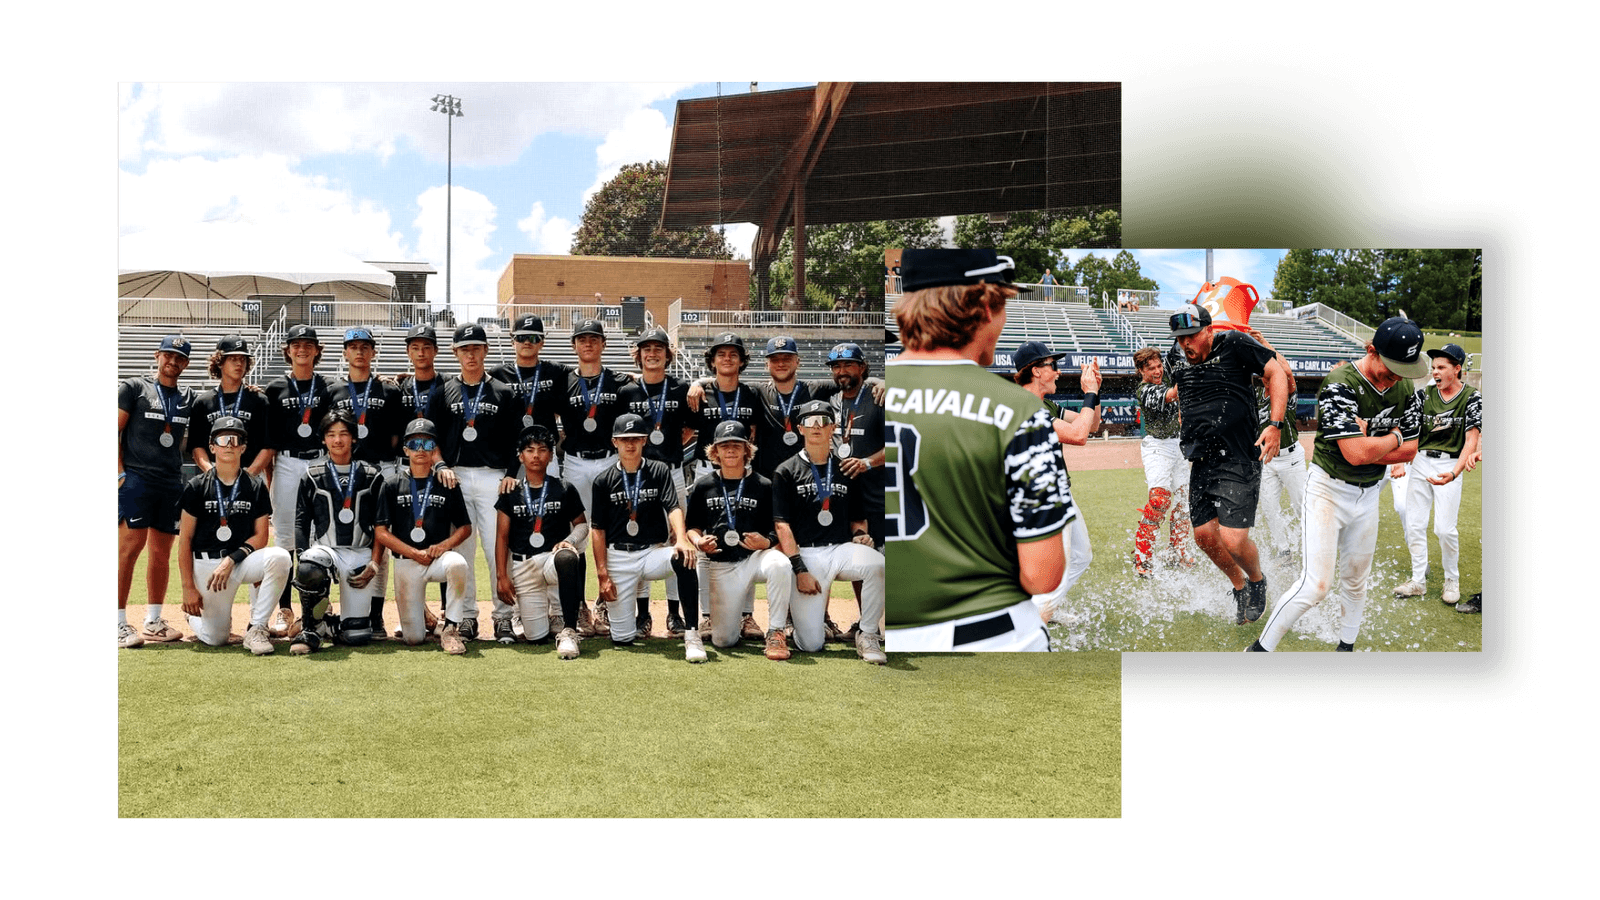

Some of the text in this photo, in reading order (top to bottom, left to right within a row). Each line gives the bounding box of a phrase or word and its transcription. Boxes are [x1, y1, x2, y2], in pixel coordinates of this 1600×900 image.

[244, 303, 259, 311] 100
[606, 308, 620, 316] 101
[683, 313, 698, 321] 102
[996, 354, 1012, 366] USA
[337, 398, 385, 409] STCED
[569, 393, 617, 404] STCED
[451, 402, 498, 413] STKED
[629, 401, 678, 410] STAED
[885, 387, 1014, 430] CAVALLO
[206, 410, 252, 421] STED
[703, 407, 753, 416] STCED
[796, 483, 848, 494] STAED
[397, 494, 446, 505] STED
[610, 488, 658, 502] STKE
[204, 500, 251, 510] STKED
[513, 501, 561, 513] STED
